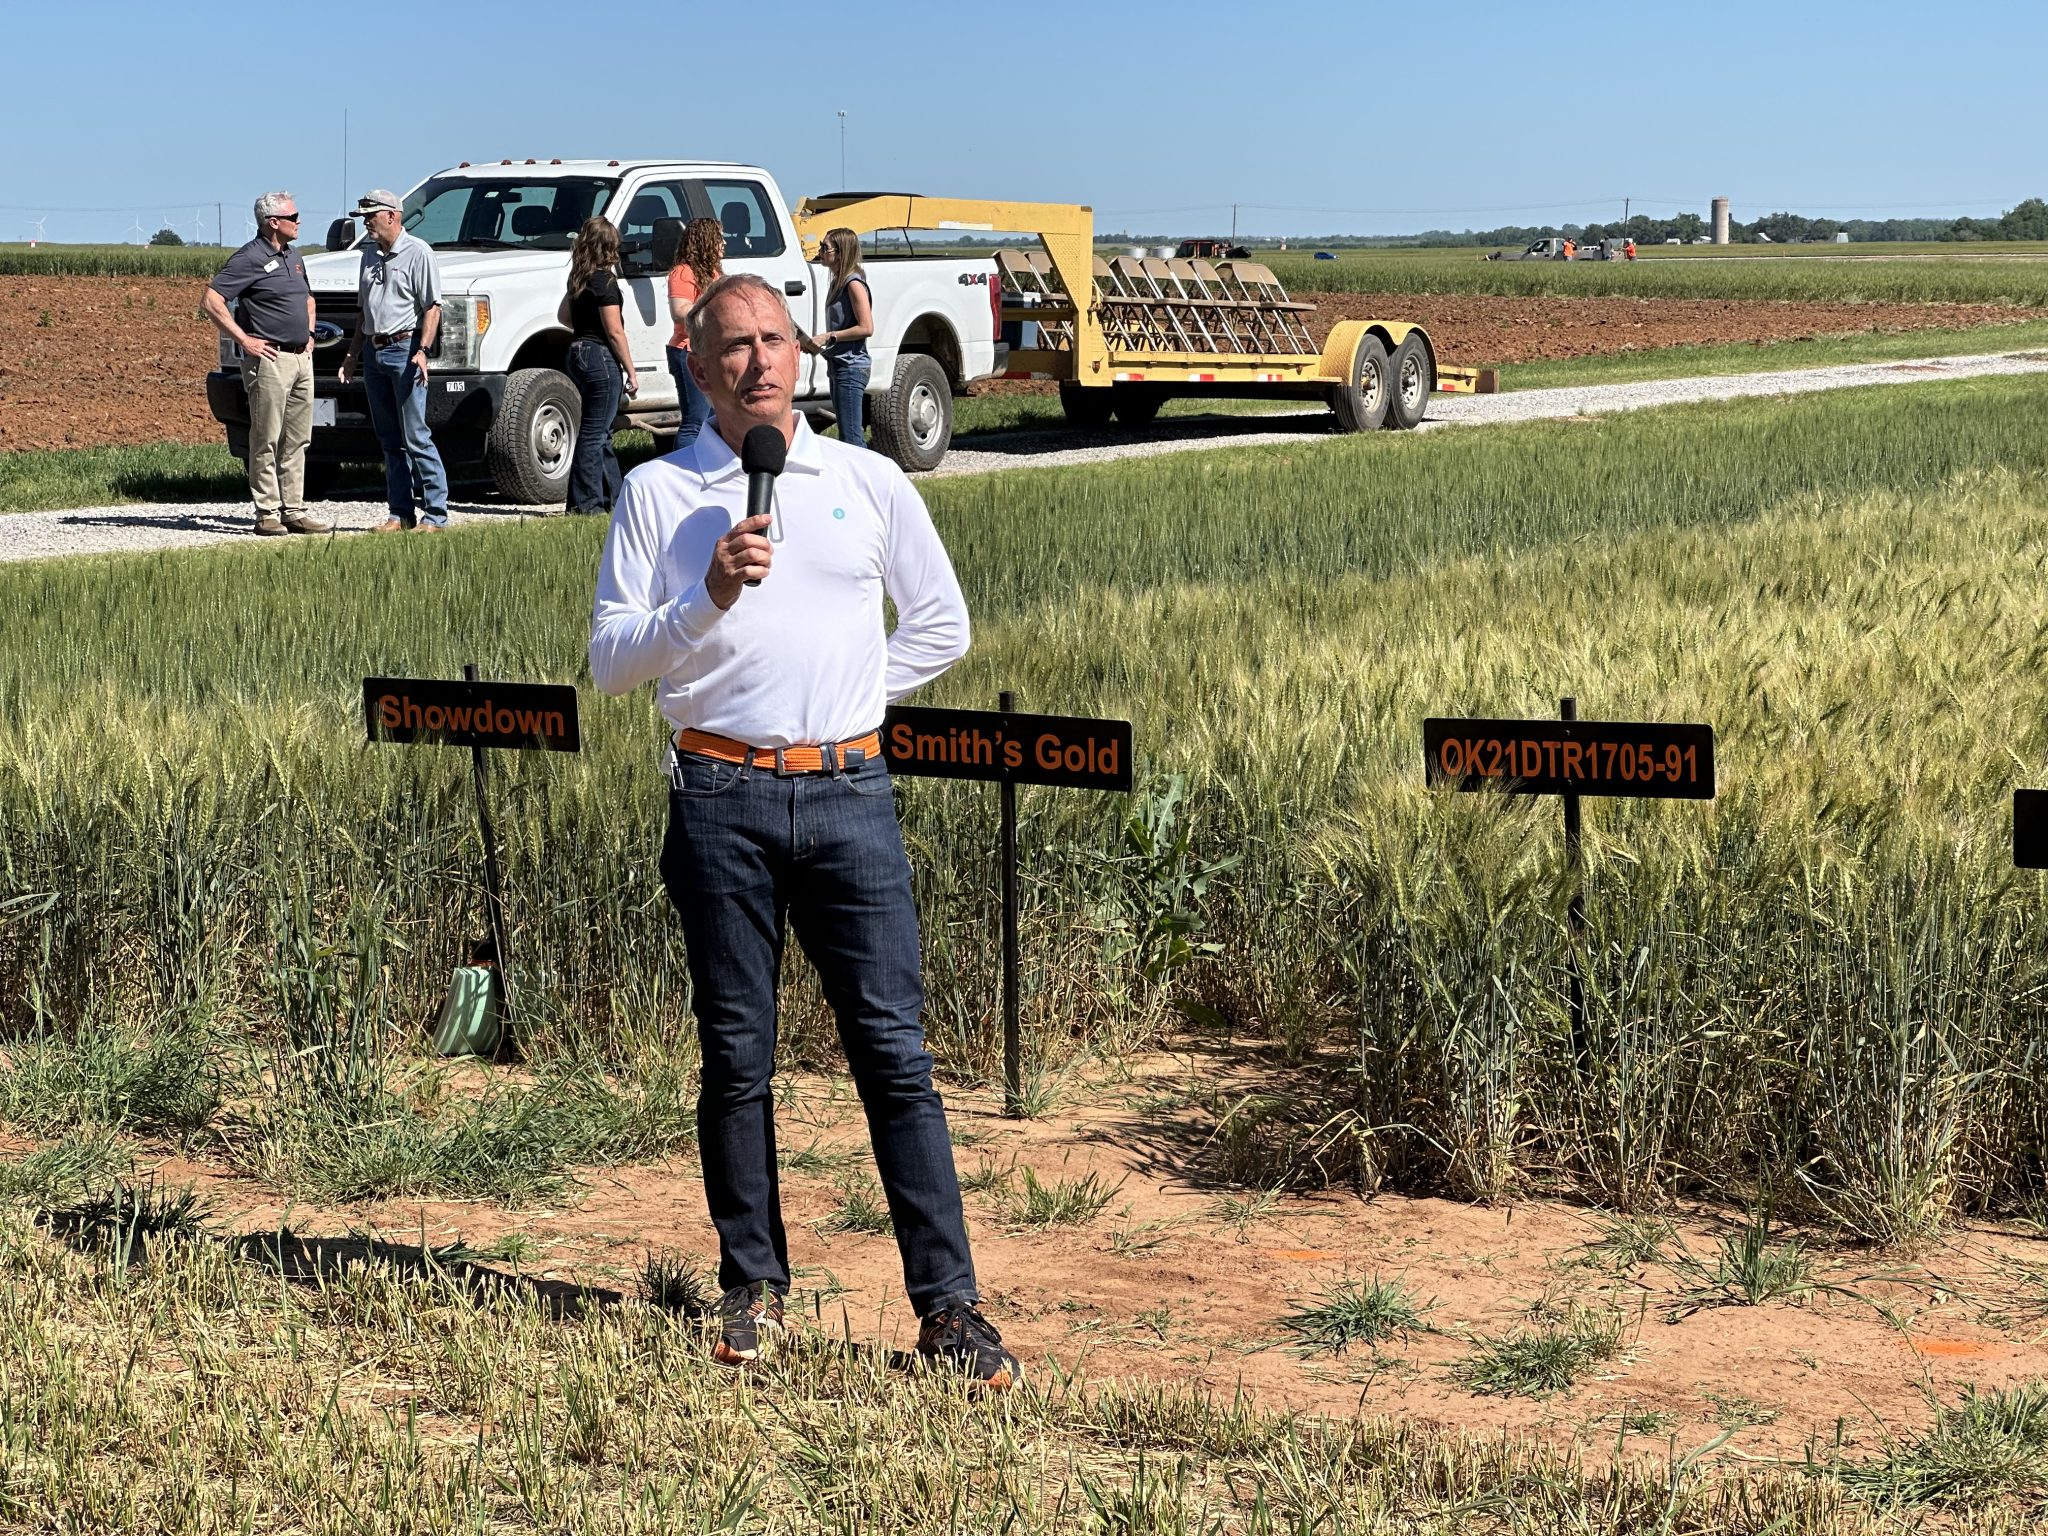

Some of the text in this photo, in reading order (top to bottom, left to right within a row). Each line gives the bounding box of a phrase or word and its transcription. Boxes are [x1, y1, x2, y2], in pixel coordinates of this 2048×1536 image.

[447, 382, 464, 391] 705
[379, 694, 565, 737] Showdown
[891, 723, 1119, 775] Smith's Gold
[1440, 738, 1697, 783] OK21DTR1705-91
